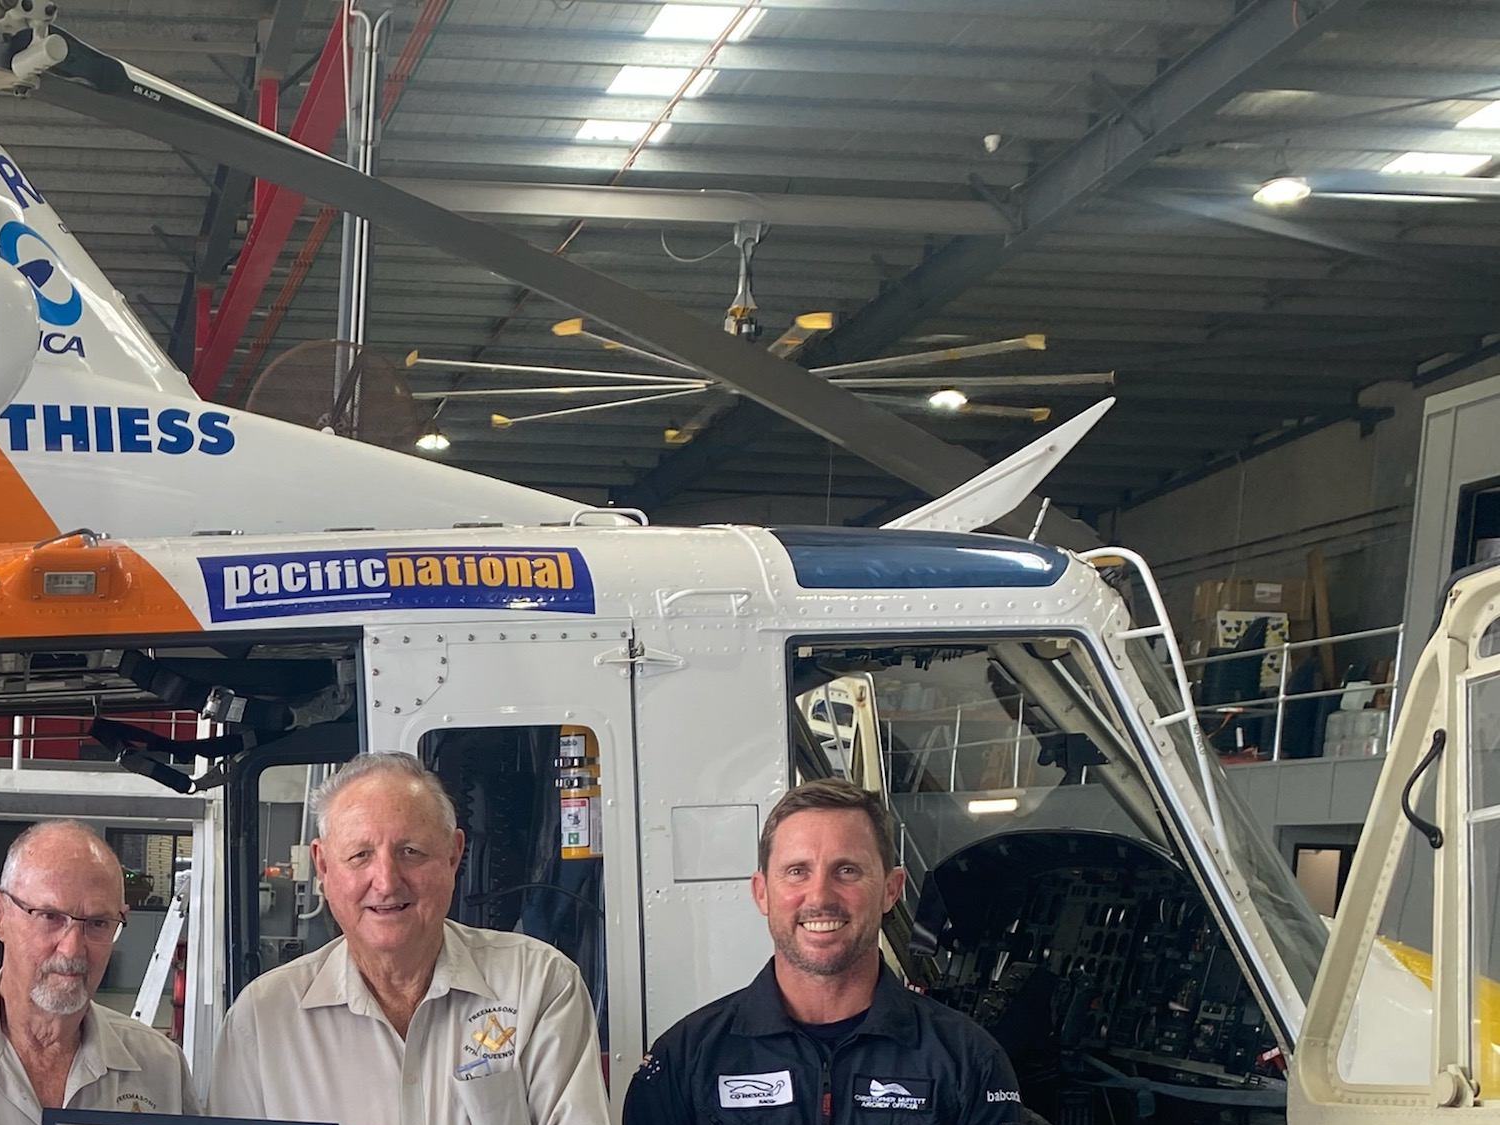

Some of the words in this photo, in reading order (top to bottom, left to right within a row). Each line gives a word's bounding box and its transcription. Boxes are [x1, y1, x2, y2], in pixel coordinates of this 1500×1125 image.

[0, 404, 236, 456] THIESS
[223, 558, 388, 610] pacific
[388, 552, 574, 590] national
[468, 1006, 517, 1023] FREEMASONS
